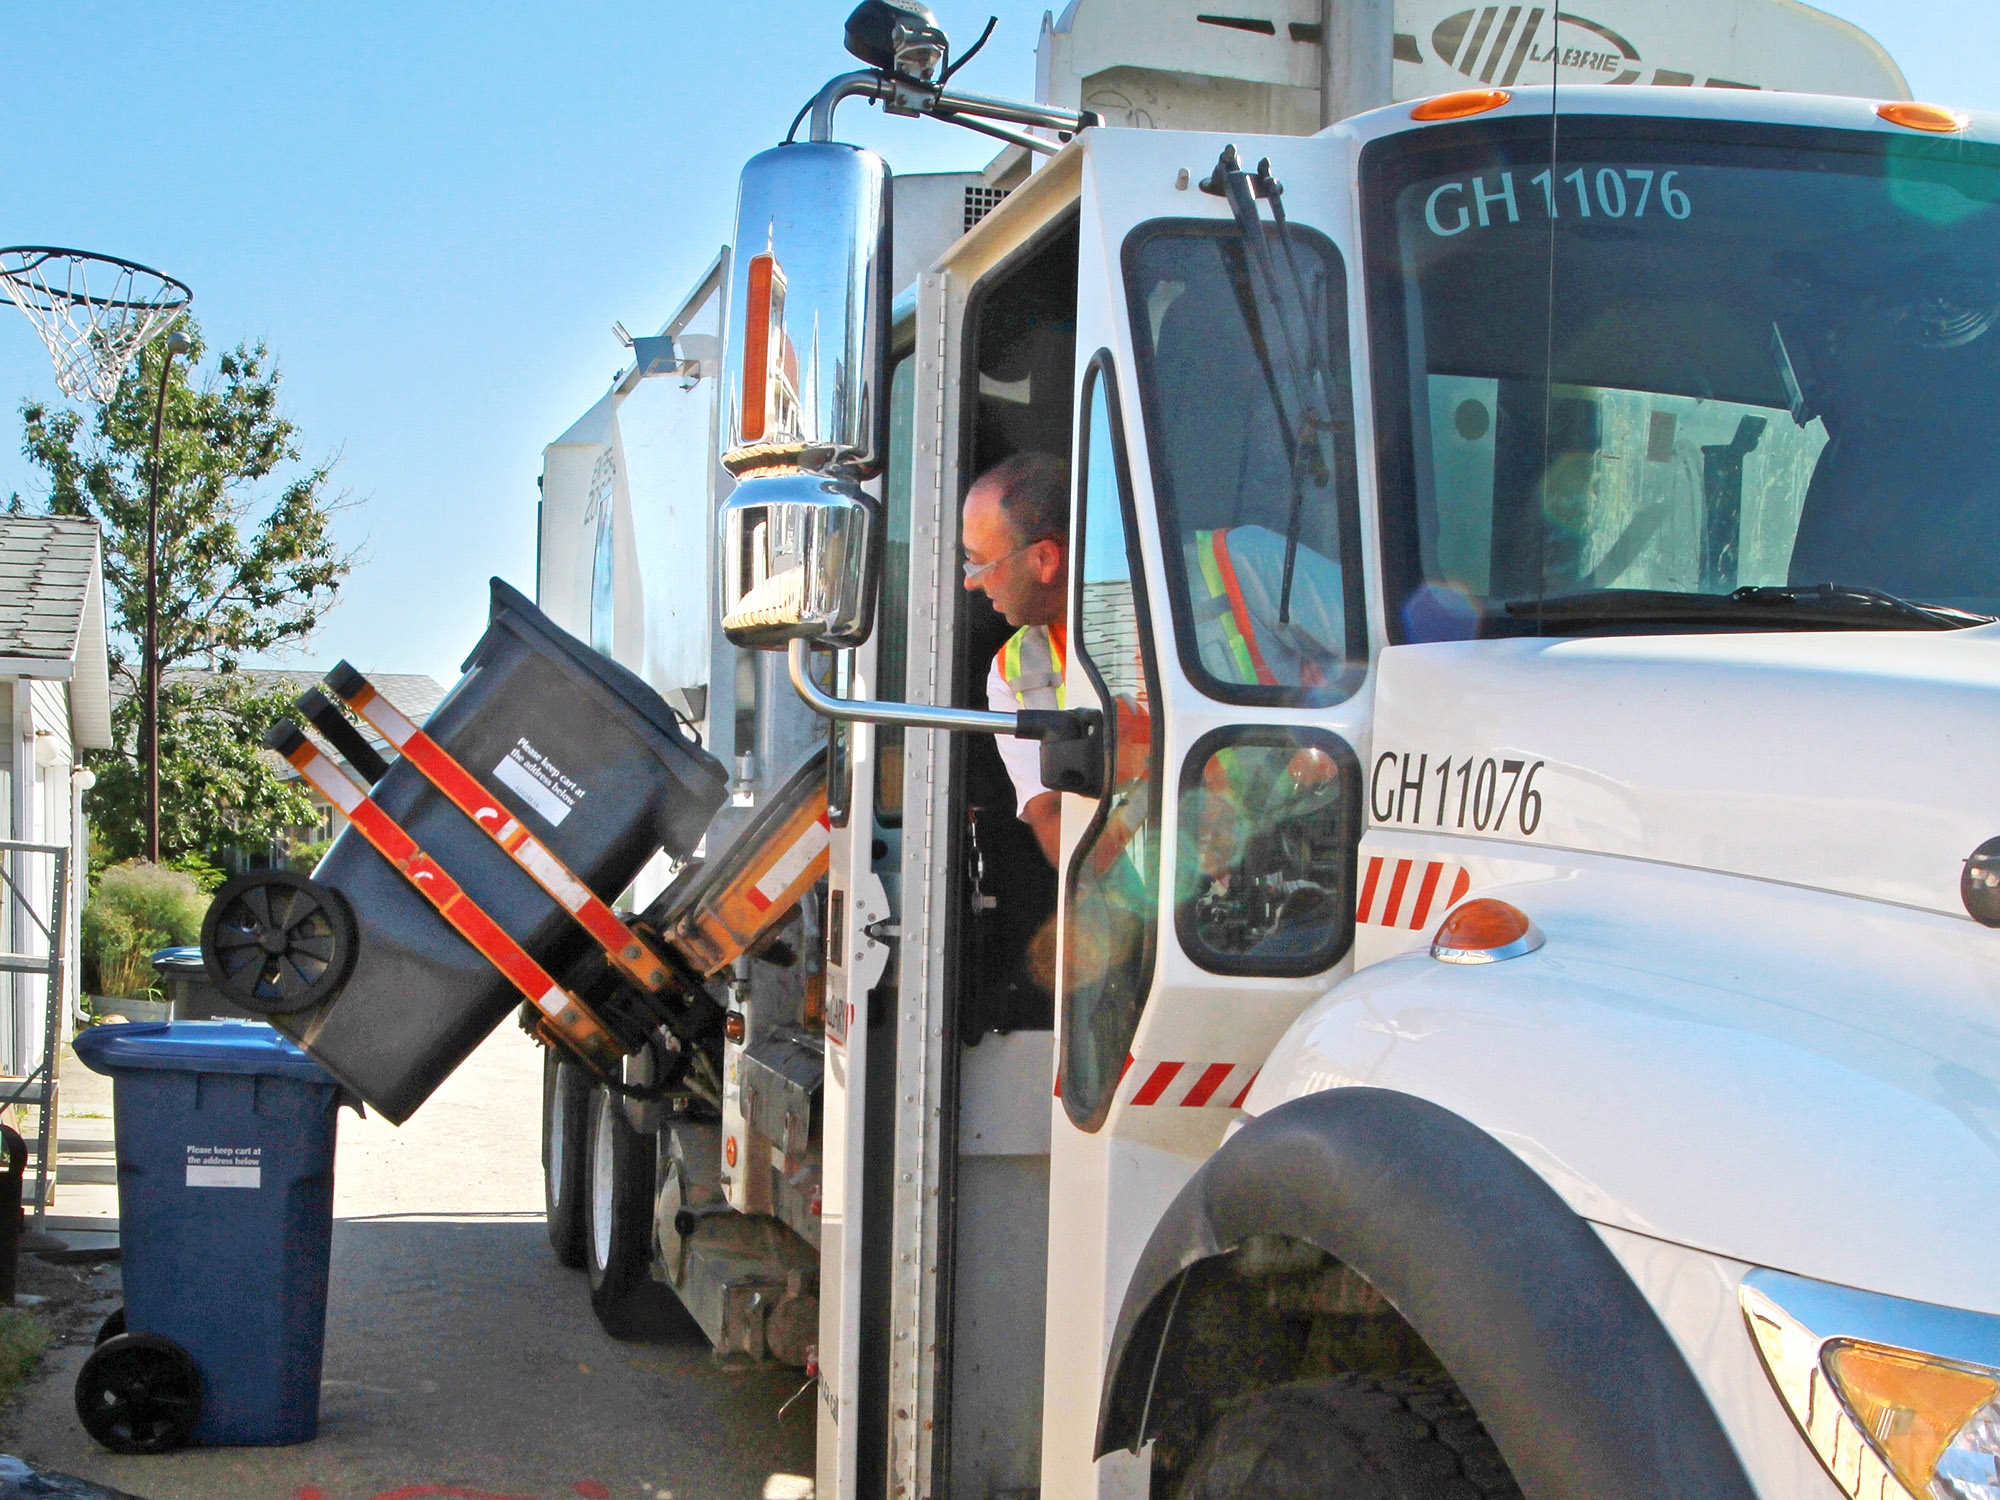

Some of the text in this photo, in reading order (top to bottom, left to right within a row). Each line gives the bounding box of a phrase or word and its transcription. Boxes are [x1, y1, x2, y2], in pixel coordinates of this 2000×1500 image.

[1528, 43, 1621, 73] LABRIE
[1425, 167, 1691, 237] GH 11076
[510, 748, 575, 806] the address below
[517, 737, 586, 798] Please keep cart at
[1371, 751, 1545, 836] GH 11076
[186, 1145, 212, 1154] Please
[213, 1146, 233, 1156] keep
[234, 1147, 251, 1155] cart
[187, 1156, 259, 1165] the address below
